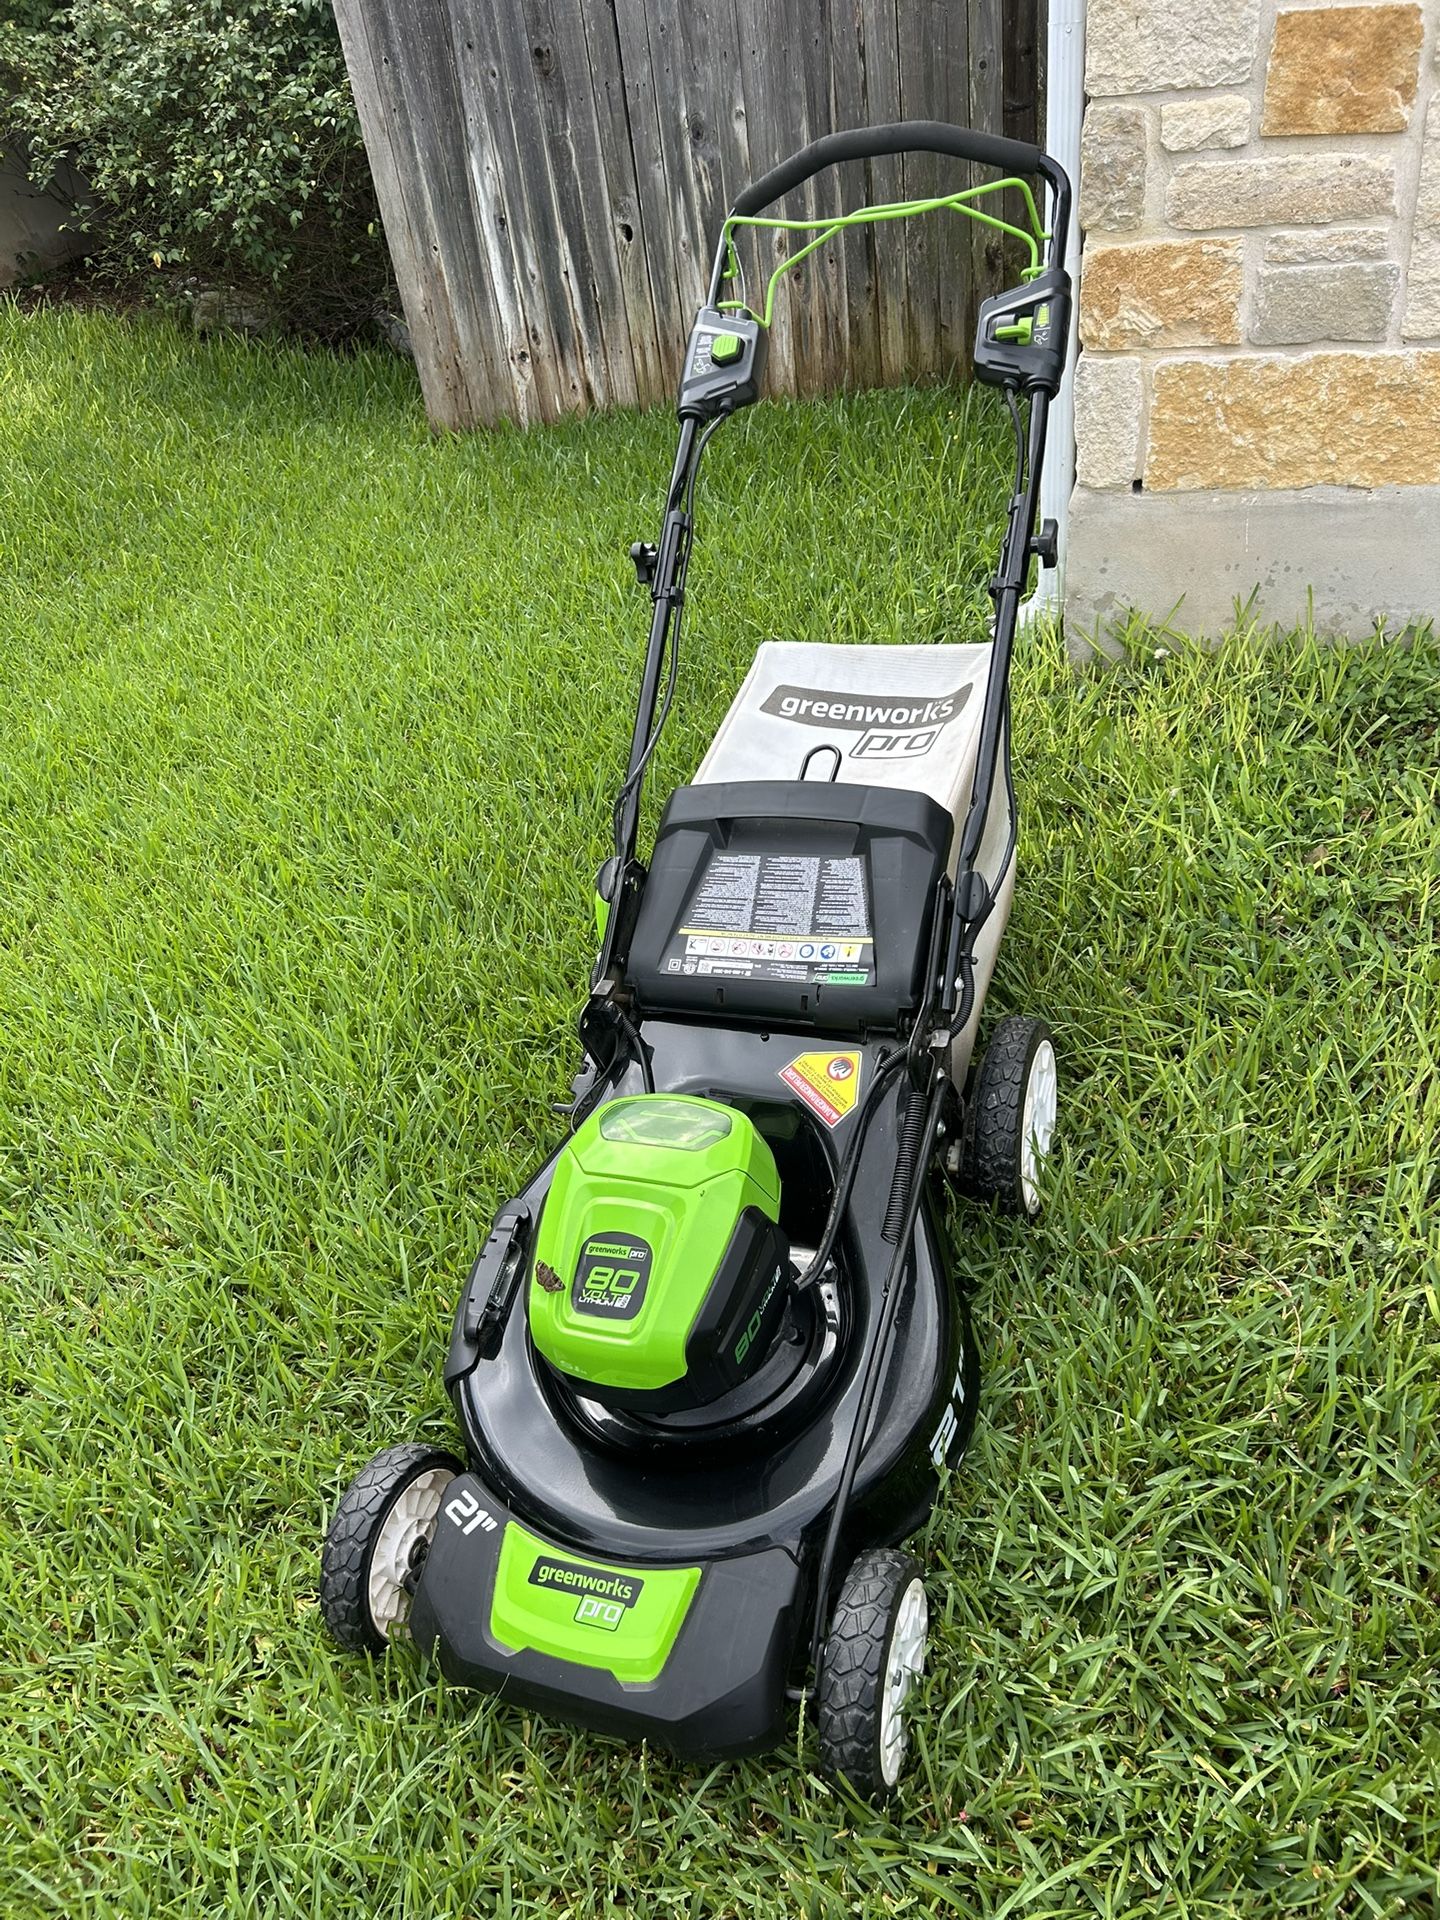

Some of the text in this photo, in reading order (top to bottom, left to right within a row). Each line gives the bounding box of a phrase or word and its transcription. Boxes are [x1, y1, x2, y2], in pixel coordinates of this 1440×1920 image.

[779, 696, 954, 724] greenworks
[856, 731, 936, 756] pro
[588, 1246, 645, 1259] greenworks pro
[585, 1266, 640, 1294] 80
[582, 1289, 622, 1301] VOLT
[735, 1310, 761, 1365] 80
[444, 1489, 498, 1536] 21"
[537, 1565, 633, 1600] greenworks
[576, 1597, 623, 1624] pro
